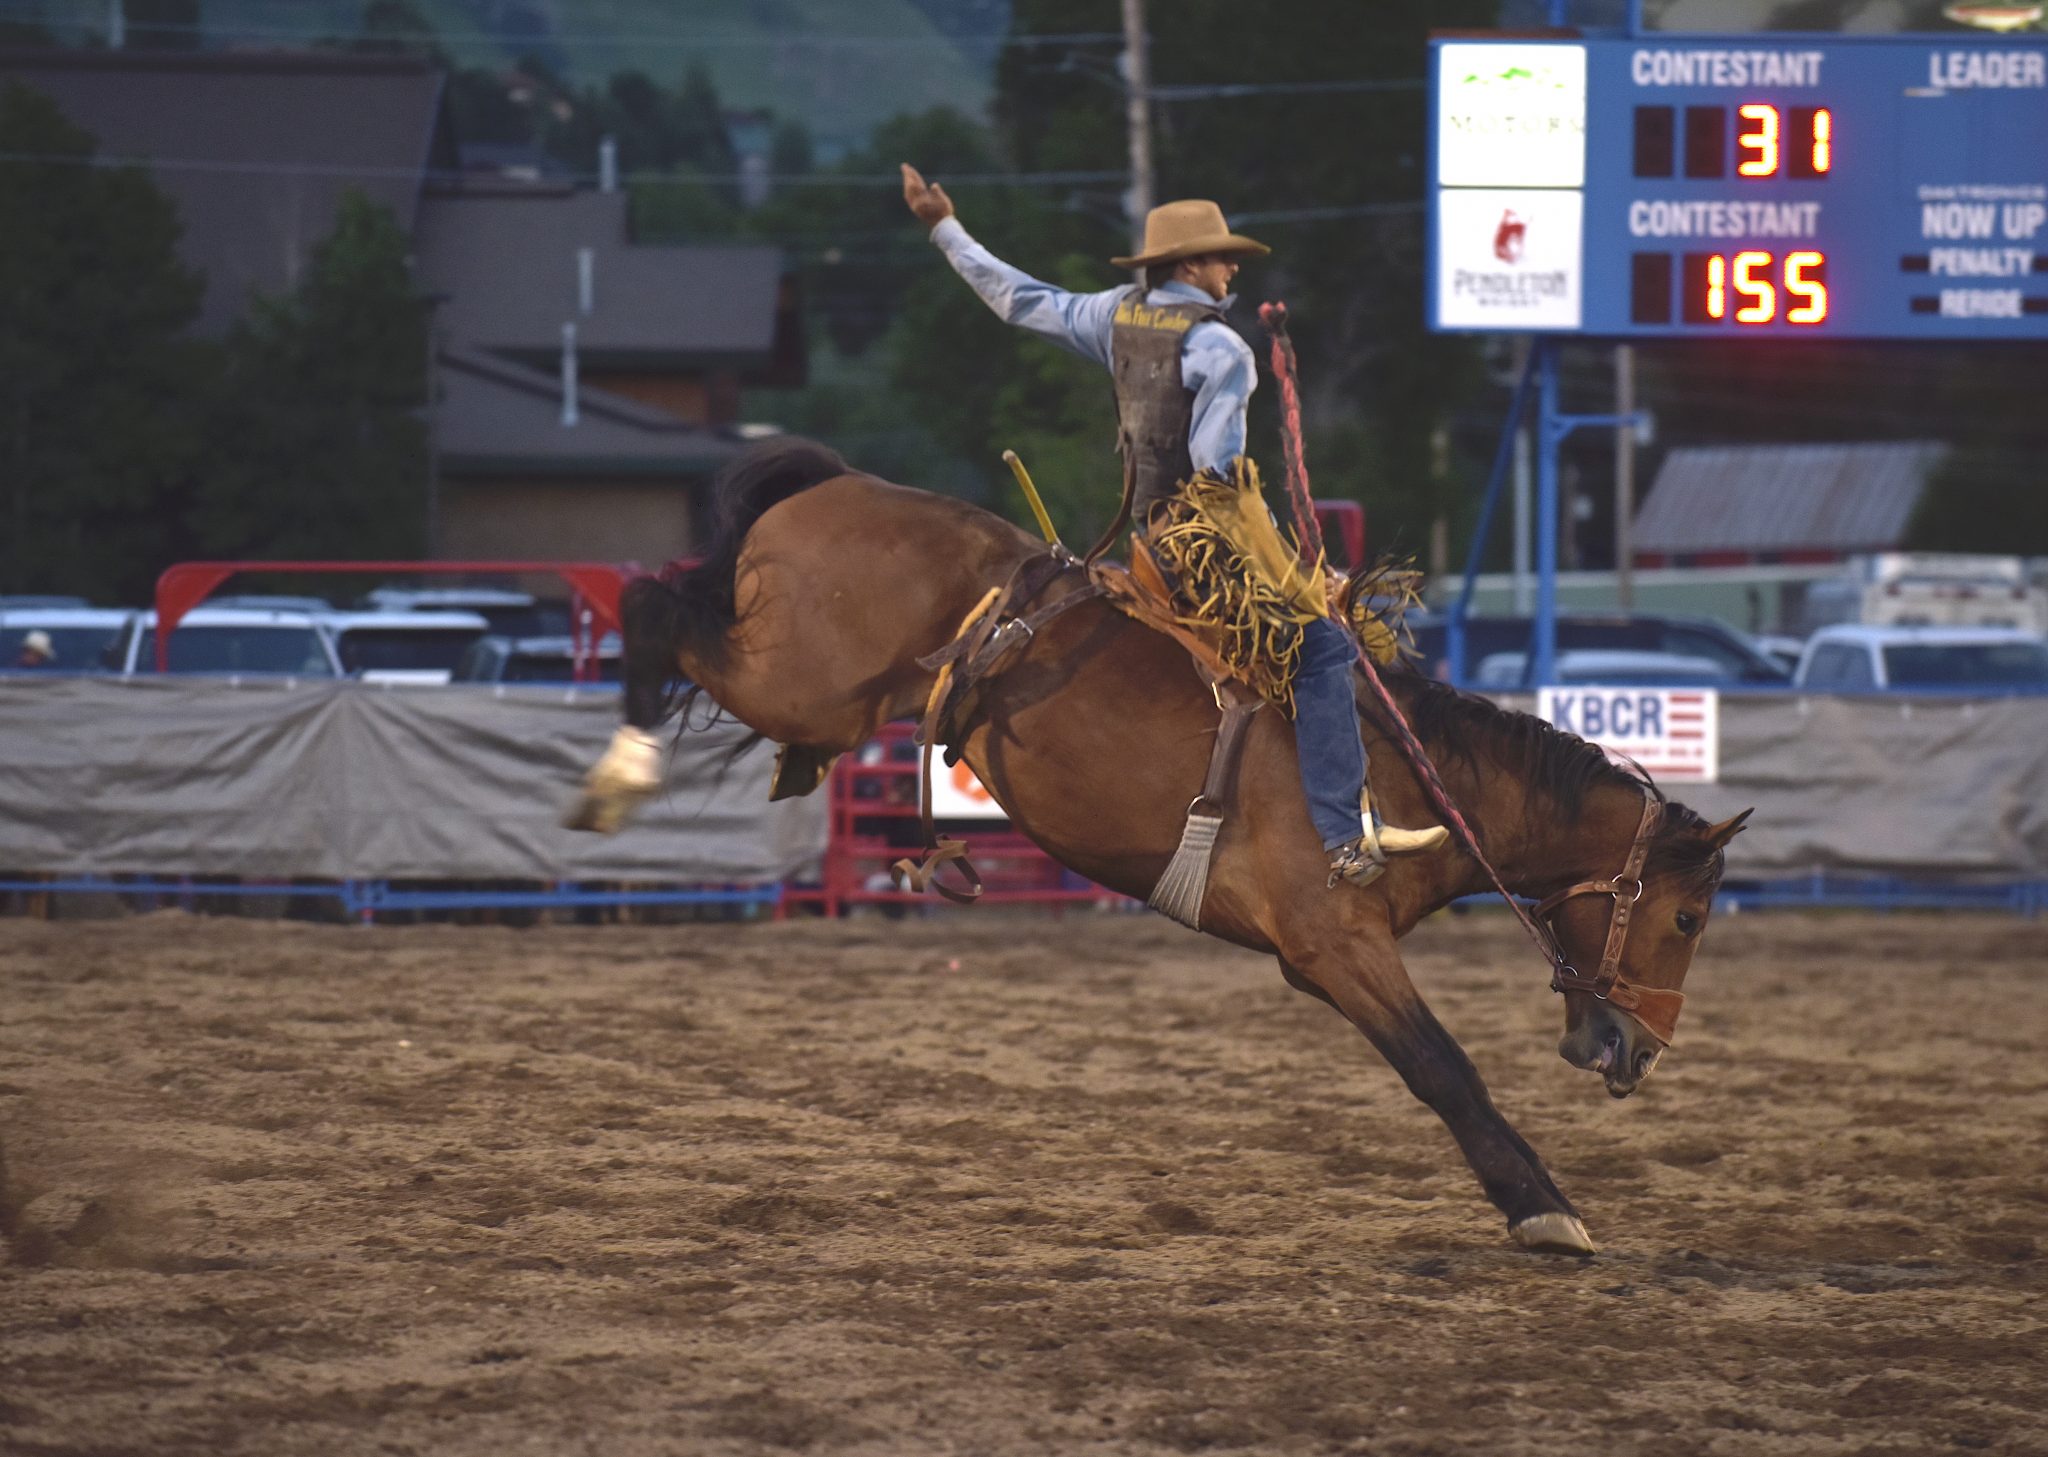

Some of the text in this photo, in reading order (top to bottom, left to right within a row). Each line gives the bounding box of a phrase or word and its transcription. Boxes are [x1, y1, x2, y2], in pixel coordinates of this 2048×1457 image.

[1632, 50, 1824, 86] CONTESTANT
[1930, 51, 2045, 88] LEADER
[1737, 104, 1831, 176] 31
[1629, 200, 1821, 237] CONTESTANT
[1922, 202, 2045, 239] NOW UP
[1930, 247, 2033, 277] PENALTY
[1706, 250, 1828, 324] 155
[1551, 694, 1663, 736] KBCR
